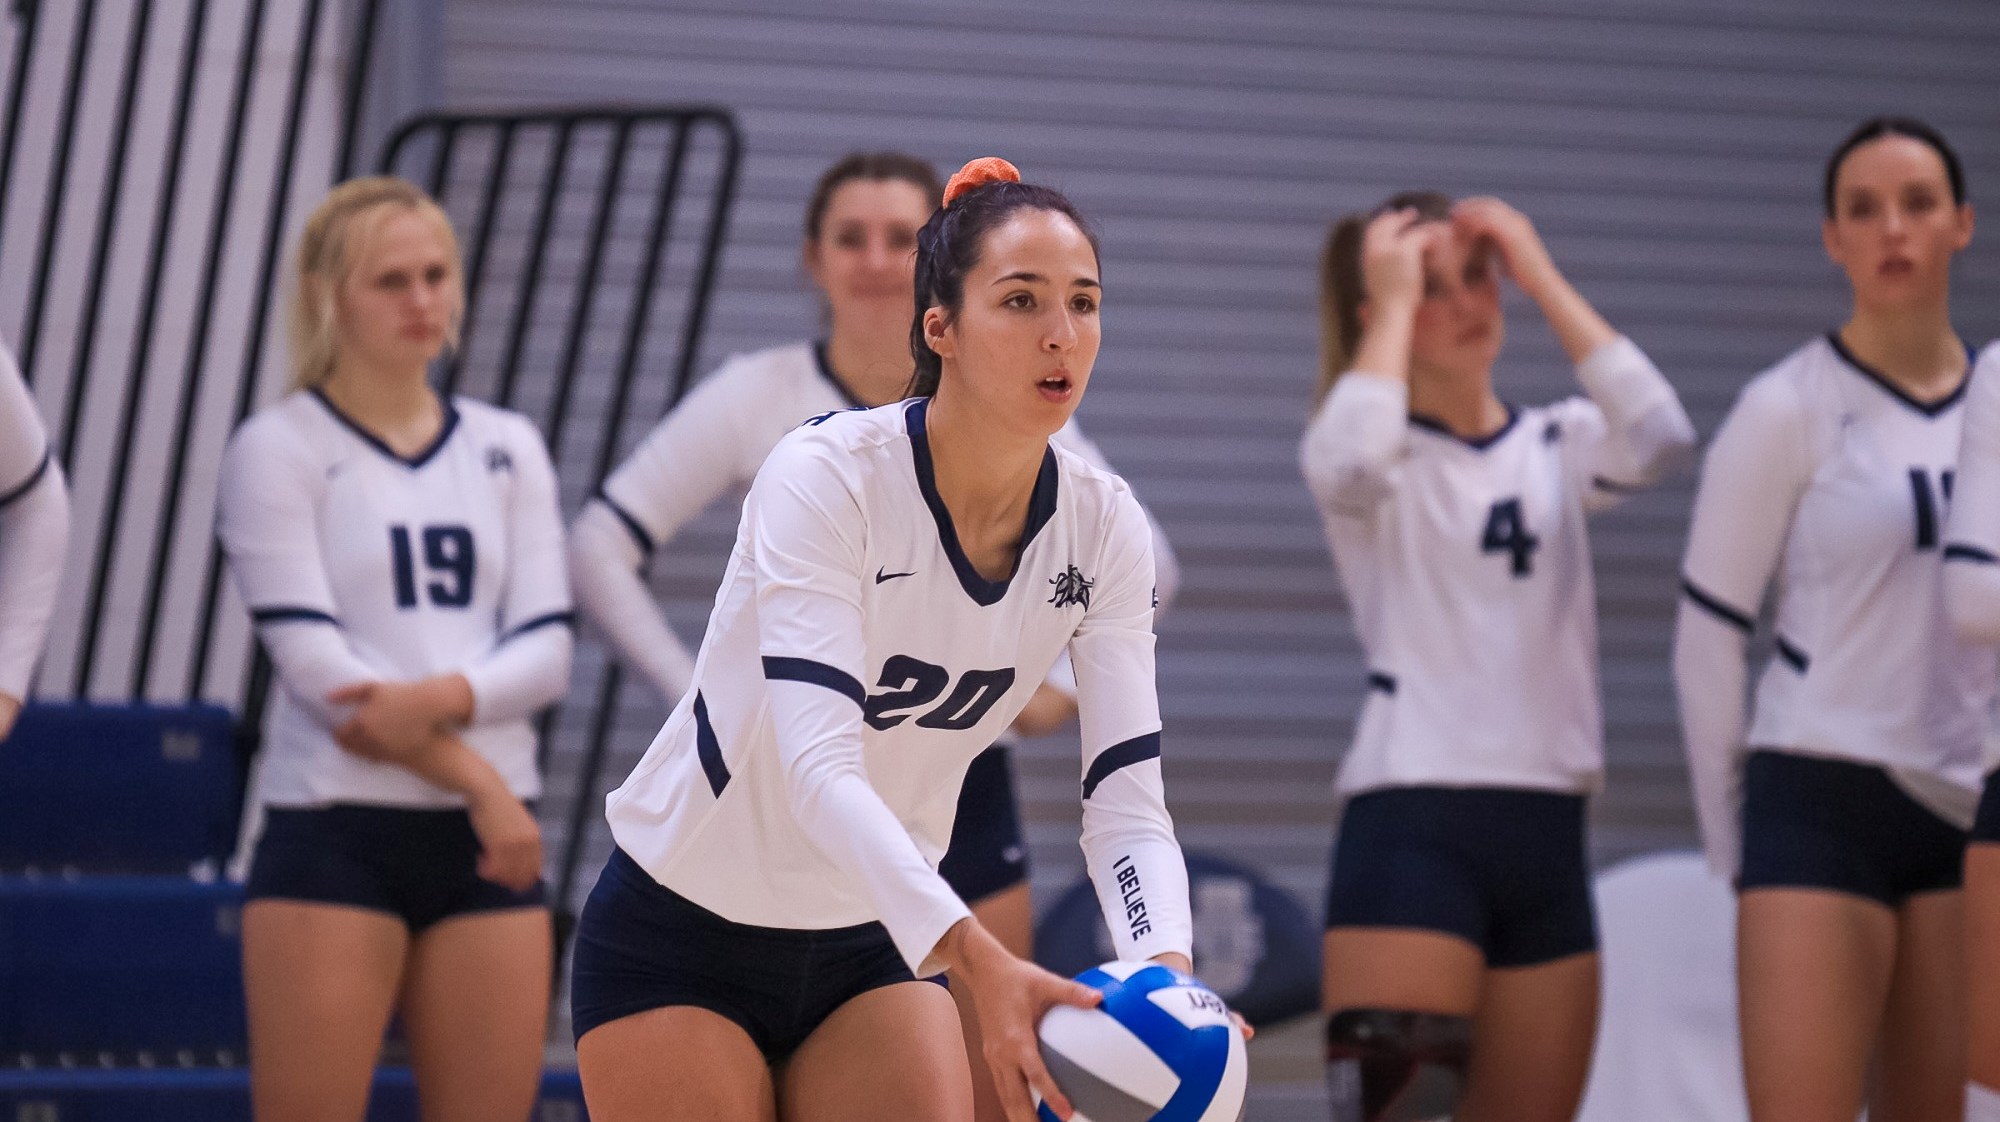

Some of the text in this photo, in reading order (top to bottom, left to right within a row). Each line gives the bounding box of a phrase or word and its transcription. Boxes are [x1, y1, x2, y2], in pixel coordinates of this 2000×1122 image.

[1481, 498, 1539, 577] 4
[1910, 468, 1954, 549] 1
[391, 525, 474, 608] 19
[864, 654, 1016, 732] 20
[1113, 855, 1152, 942] I BELIEVE
